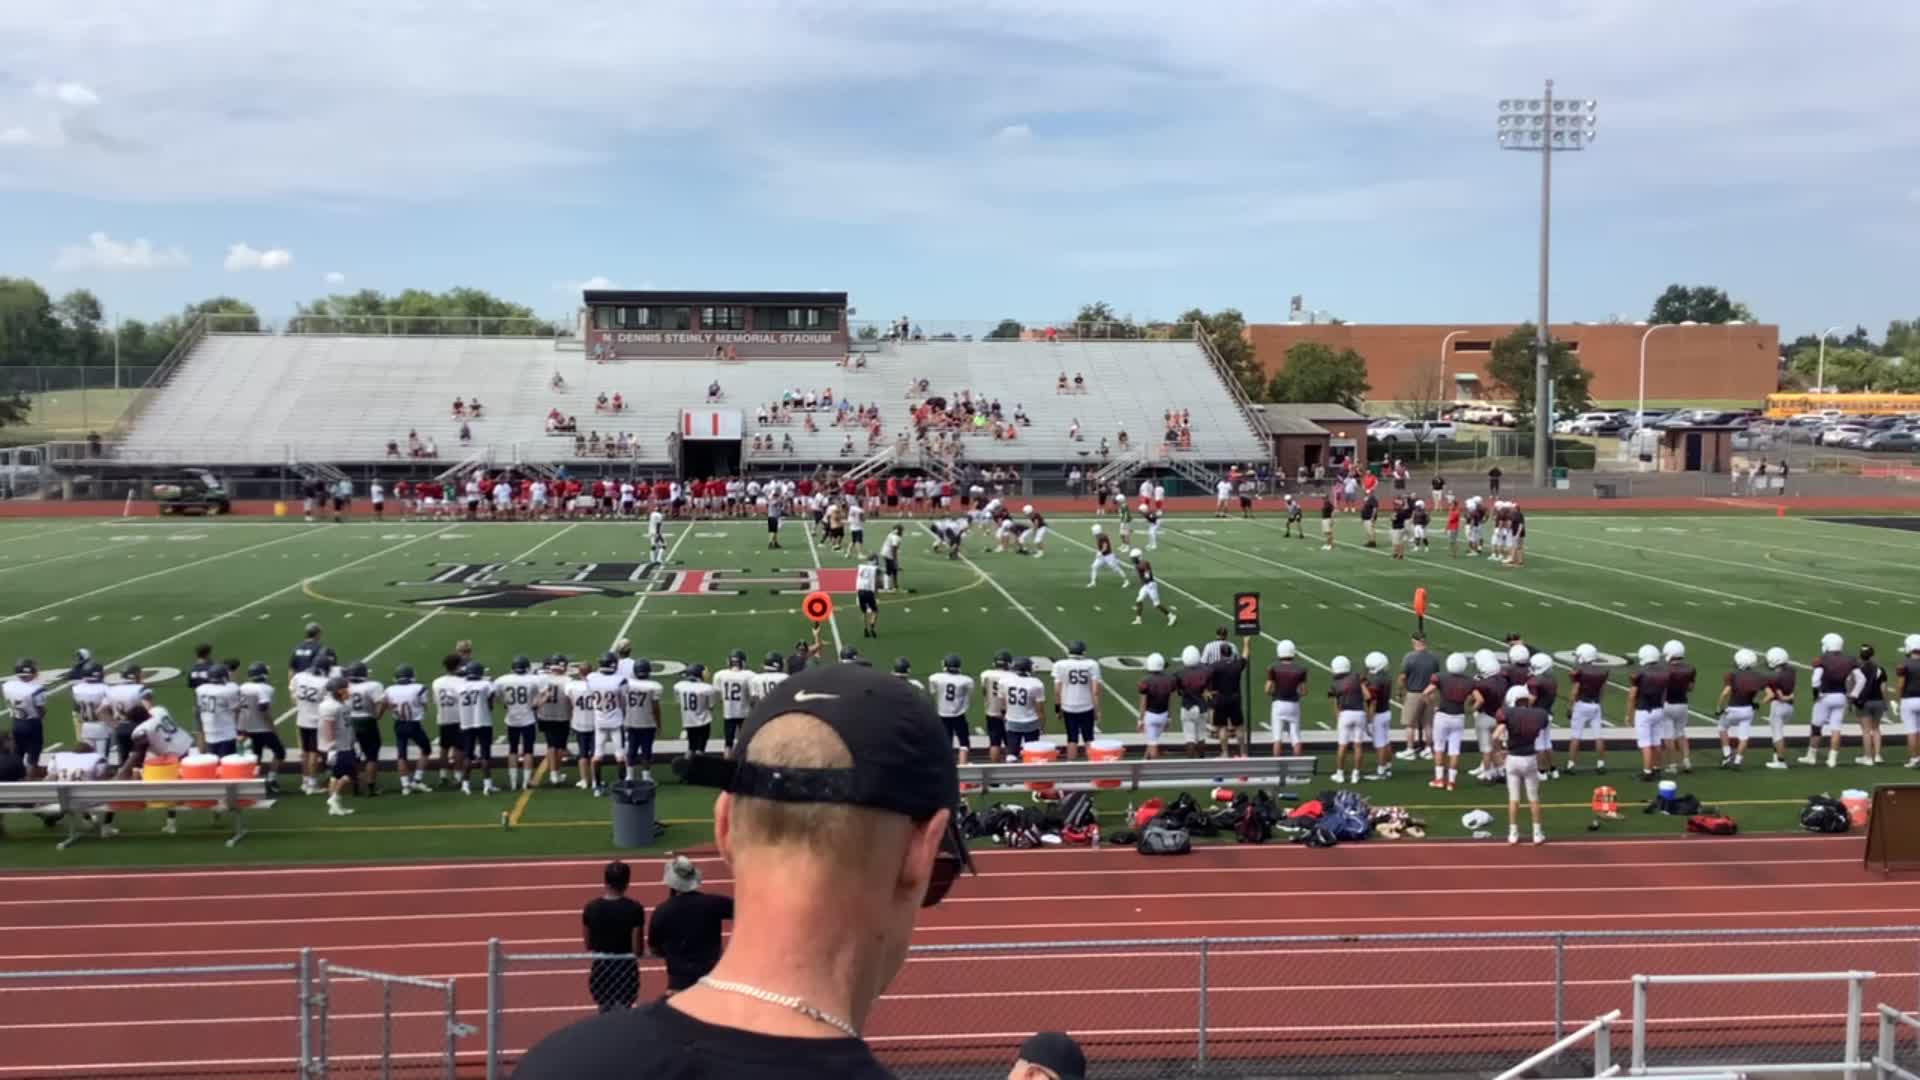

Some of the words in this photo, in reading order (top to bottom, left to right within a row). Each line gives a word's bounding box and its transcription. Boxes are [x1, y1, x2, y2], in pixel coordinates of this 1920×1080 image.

[617, 333, 661, 343] DENNIS
[715, 333, 777, 344] MEMORIAL
[780, 334, 832, 344] STADIUM
[1238, 596, 1257, 620] 2
[1068, 669, 1089, 685] 65
[297, 685, 318, 703] 32
[460, 689, 480, 706] 37
[506, 686, 528, 705] 38
[628, 692, 648, 707] 67
[724, 682, 742, 701] 12
[1008, 687, 1028, 706] 53
[683, 692, 698, 711] 18
